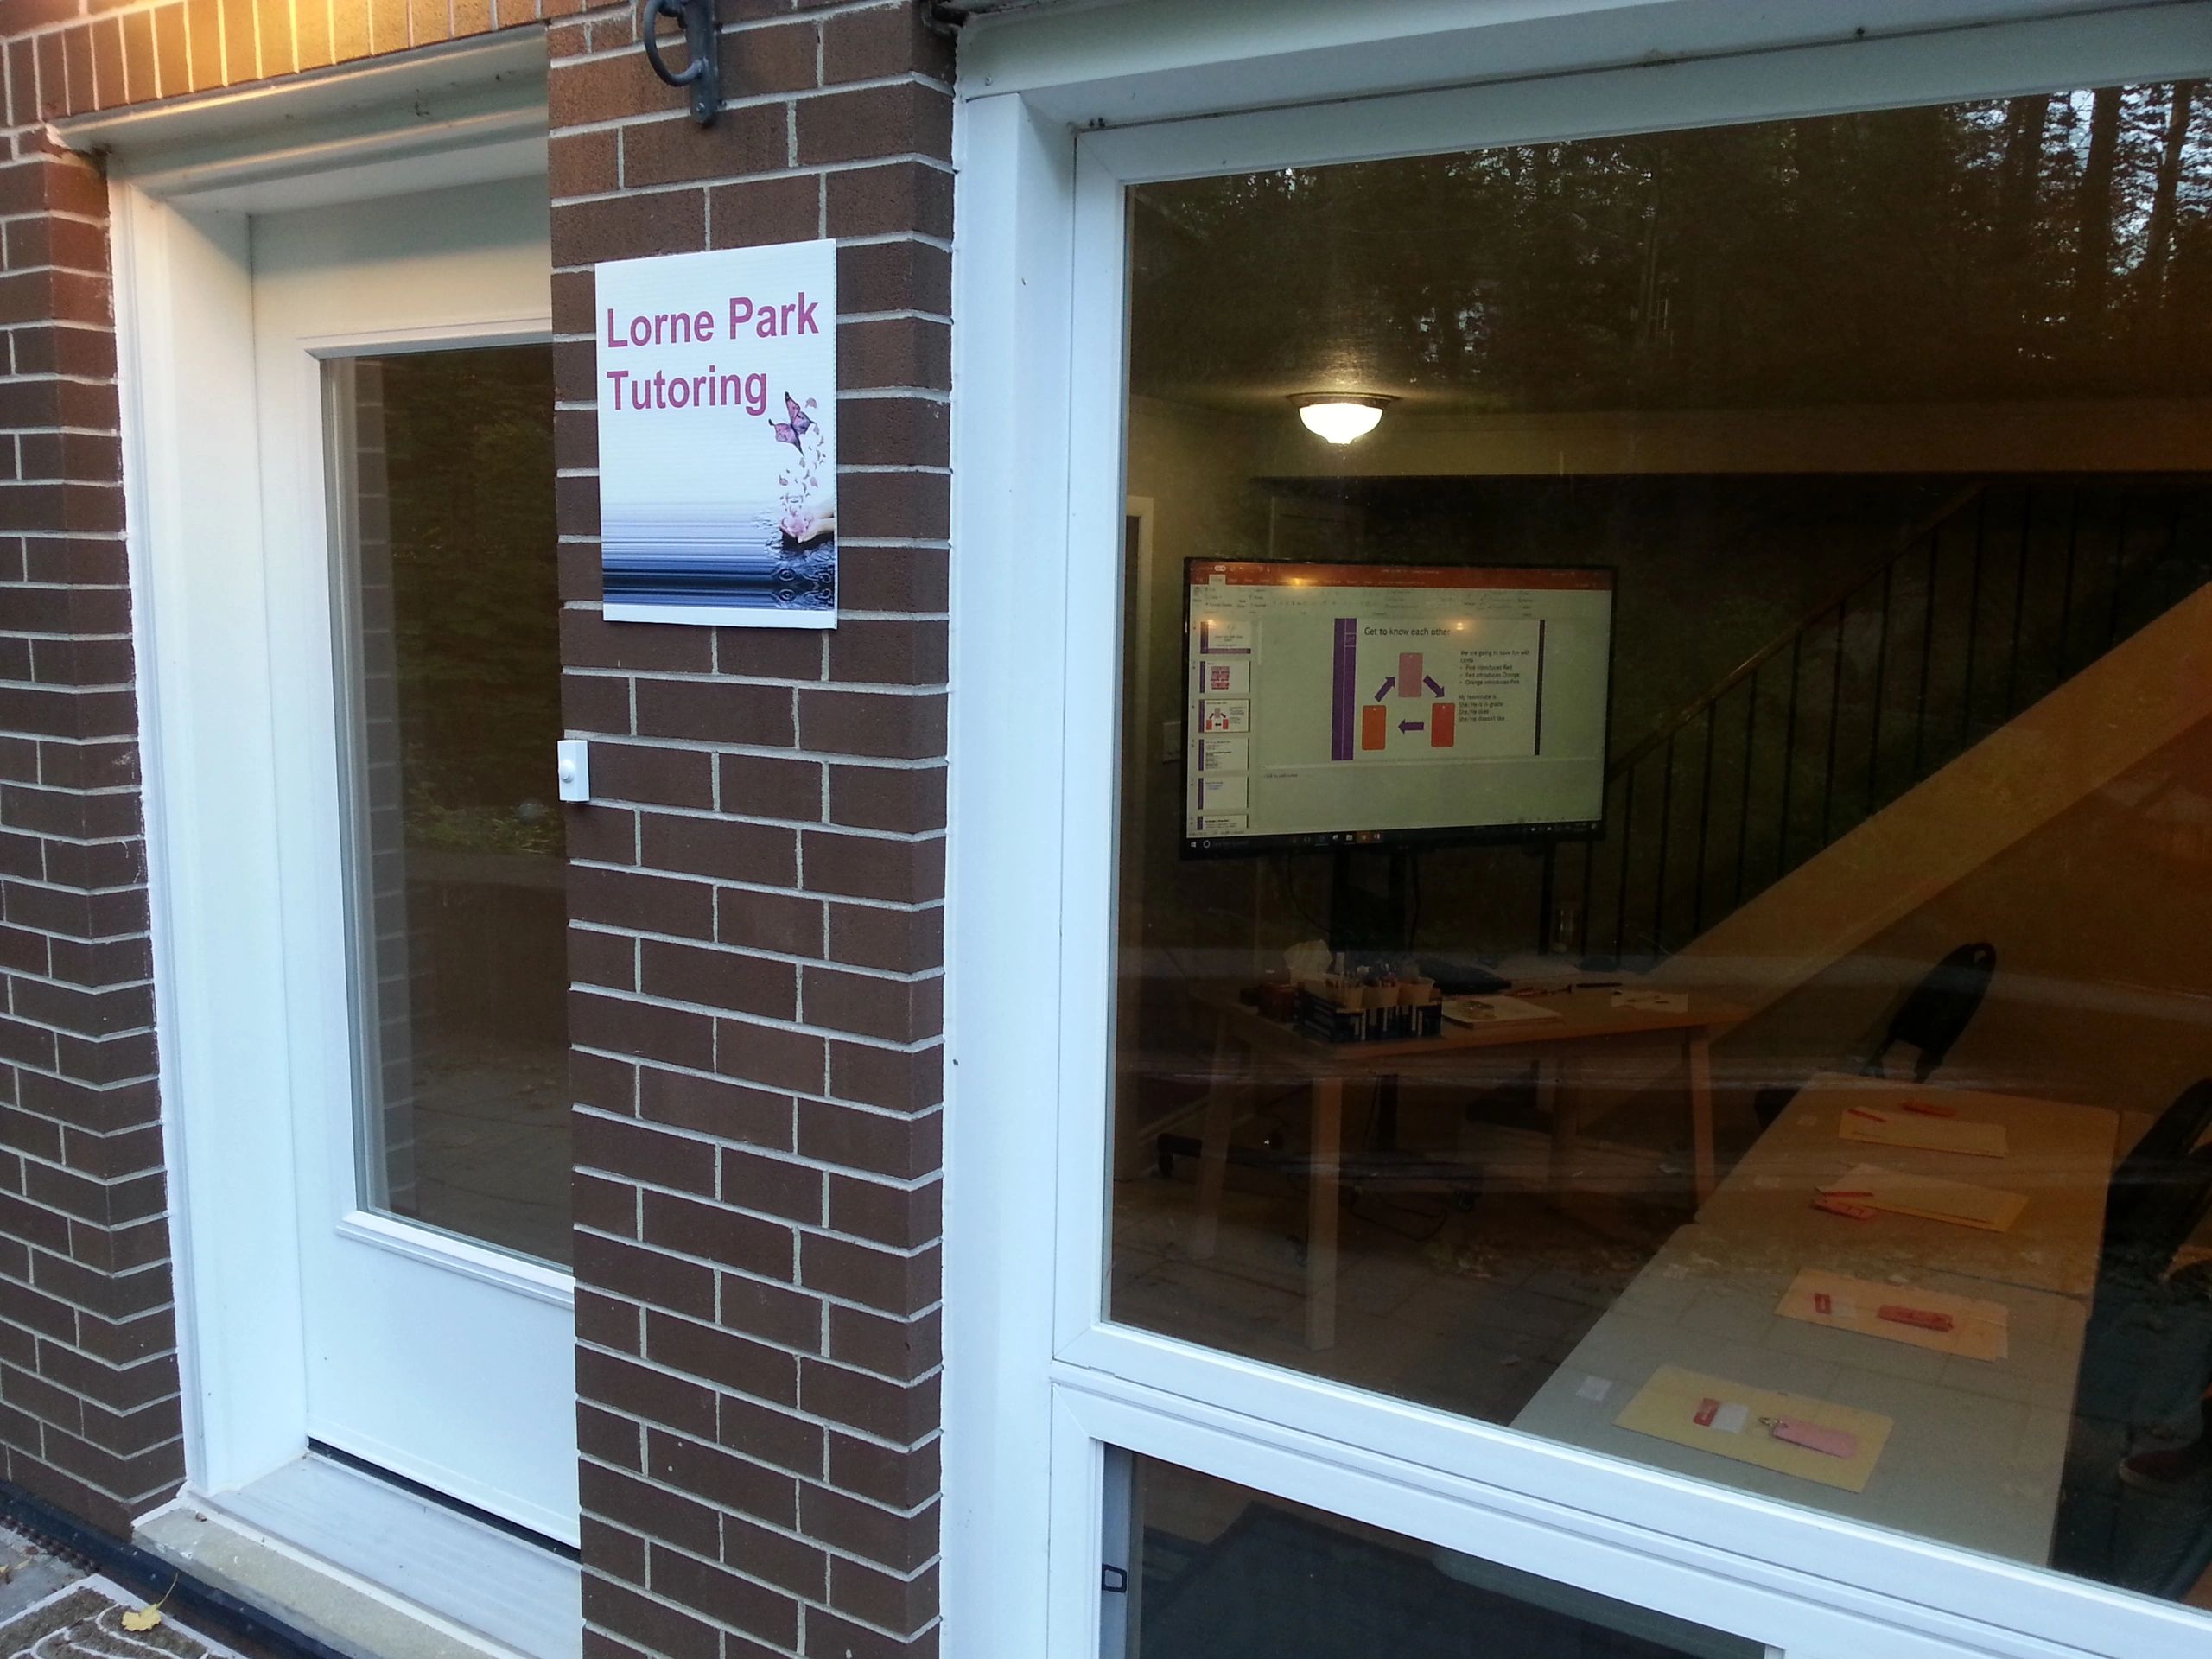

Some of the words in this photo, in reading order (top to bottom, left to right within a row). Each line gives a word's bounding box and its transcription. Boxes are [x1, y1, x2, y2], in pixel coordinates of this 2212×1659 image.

[607, 308, 715, 348] Lorne
[729, 292, 819, 340] Park
[607, 365, 768, 416] Tutoring
[1364, 626, 1377, 636] Get
[1379, 626, 1388, 636] to
[1389, 626, 1409, 636] know
[1411, 626, 1428, 636] each
[1431, 626, 1451, 636] other
